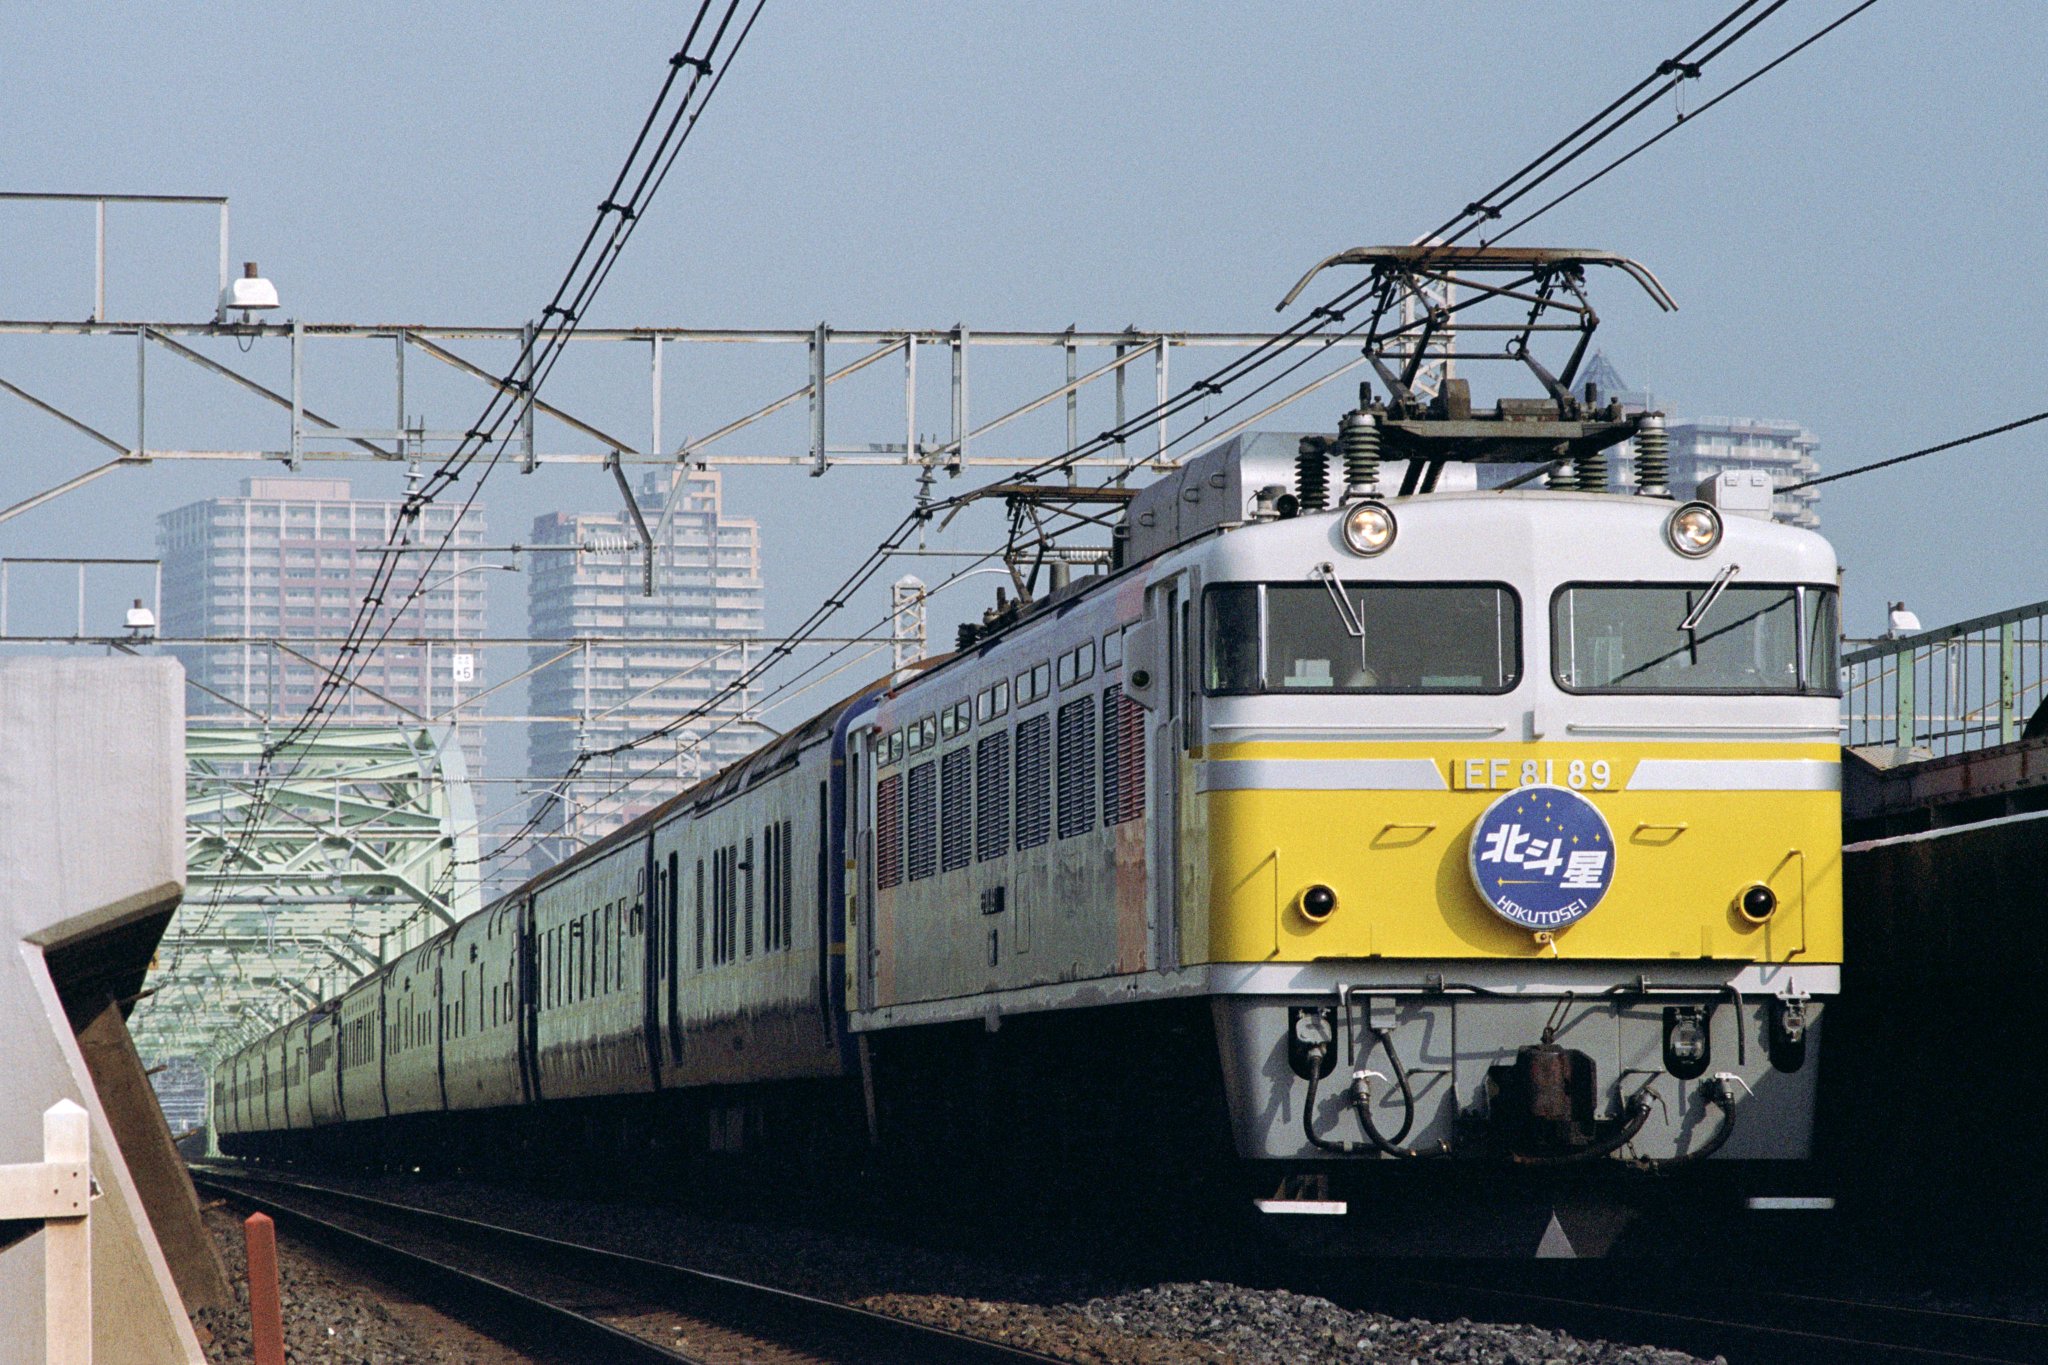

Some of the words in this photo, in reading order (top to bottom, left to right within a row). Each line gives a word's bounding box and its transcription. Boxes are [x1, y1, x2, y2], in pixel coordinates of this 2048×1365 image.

[1465, 758, 1510, 789] EF
[1520, 759, 1553, 787] 81
[1568, 759, 1610, 790] 89
[1481, 823, 1607, 888] 北斗星
[1498, 896, 1588, 924] HOKUTOSEI
